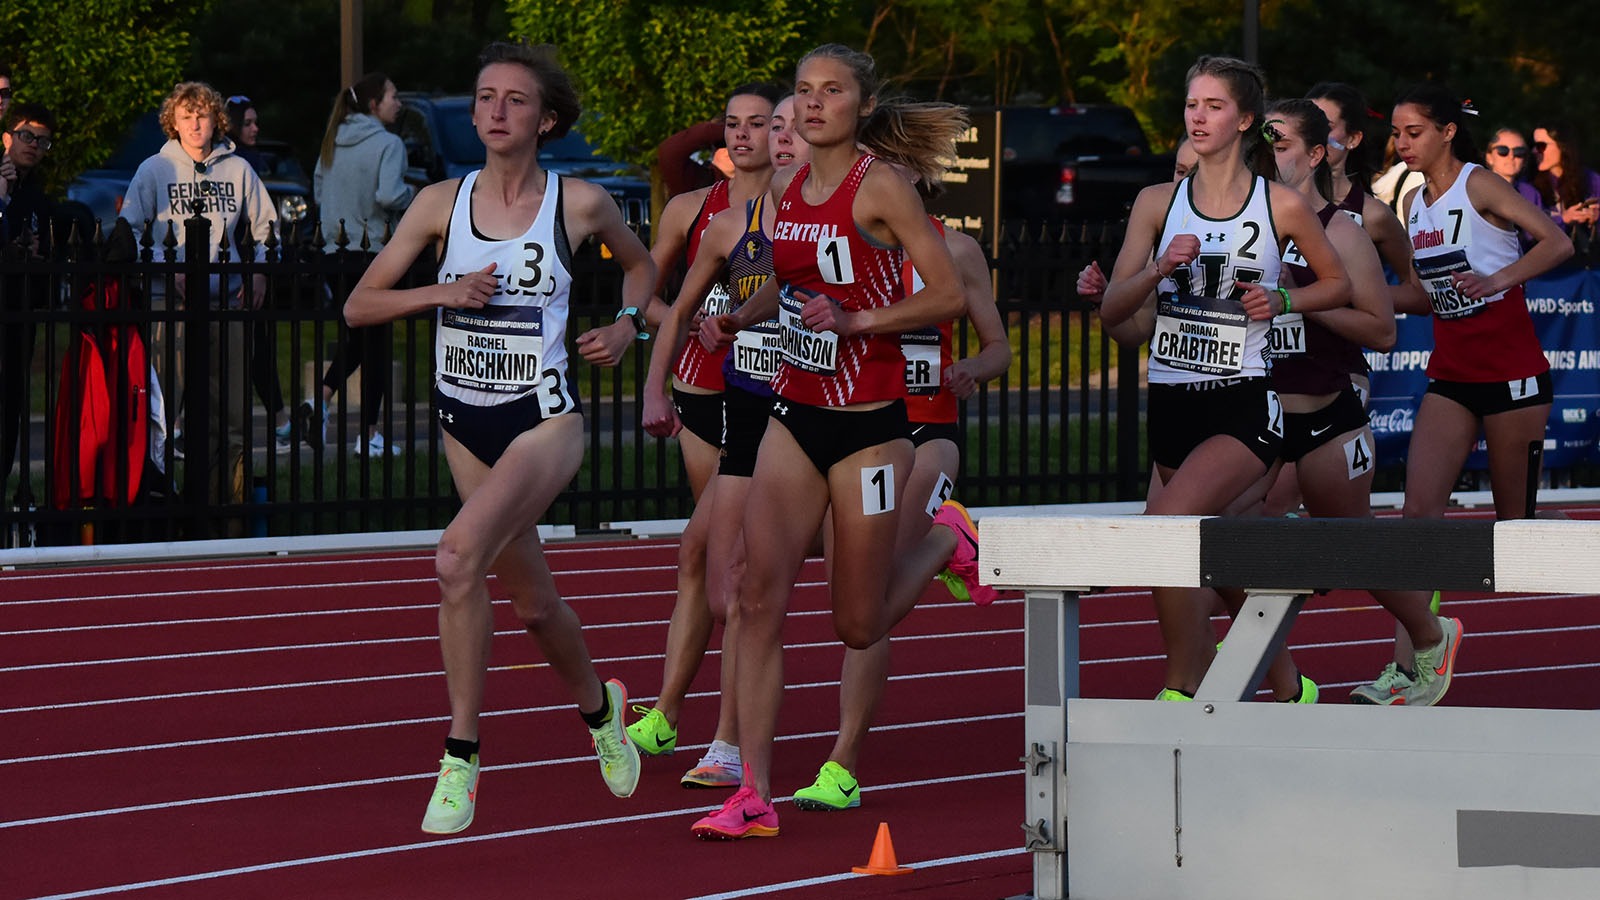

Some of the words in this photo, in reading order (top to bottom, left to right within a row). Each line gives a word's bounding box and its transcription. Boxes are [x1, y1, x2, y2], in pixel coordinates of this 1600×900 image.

[170, 198, 237, 215] KNGHTS
[774, 221, 838, 242] CENTRAL
[1237, 221, 1260, 260] 2
[1448, 209, 1463, 245] 7
[518, 242, 545, 288] 3
[824, 240, 843, 282] 1
[455, 315, 470, 323] TRACK
[474, 319, 488, 327] FIELD
[489, 320, 540, 330] CHAMPIONSHIPS
[1188, 308, 1202, 316] FIELD
[1202, 310, 1246, 322] CHAMPIONSHIPS
[1527, 298, 1558, 313] WBD
[1558, 298, 1594, 316] Sports
[467, 335, 508, 350] RACHEL
[781, 325, 833, 367] OHNSON
[1179, 322, 1219, 338] ADRIANA
[445, 345, 537, 382] HIRSCHKIND
[1157, 332, 1241, 367] CRABTREE
[906, 360, 930, 385] ER
[541, 368, 567, 415] 3
[1270, 394, 1282, 434] 2
[1352, 438, 1370, 472] 4
[871, 469, 887, 511] 1
